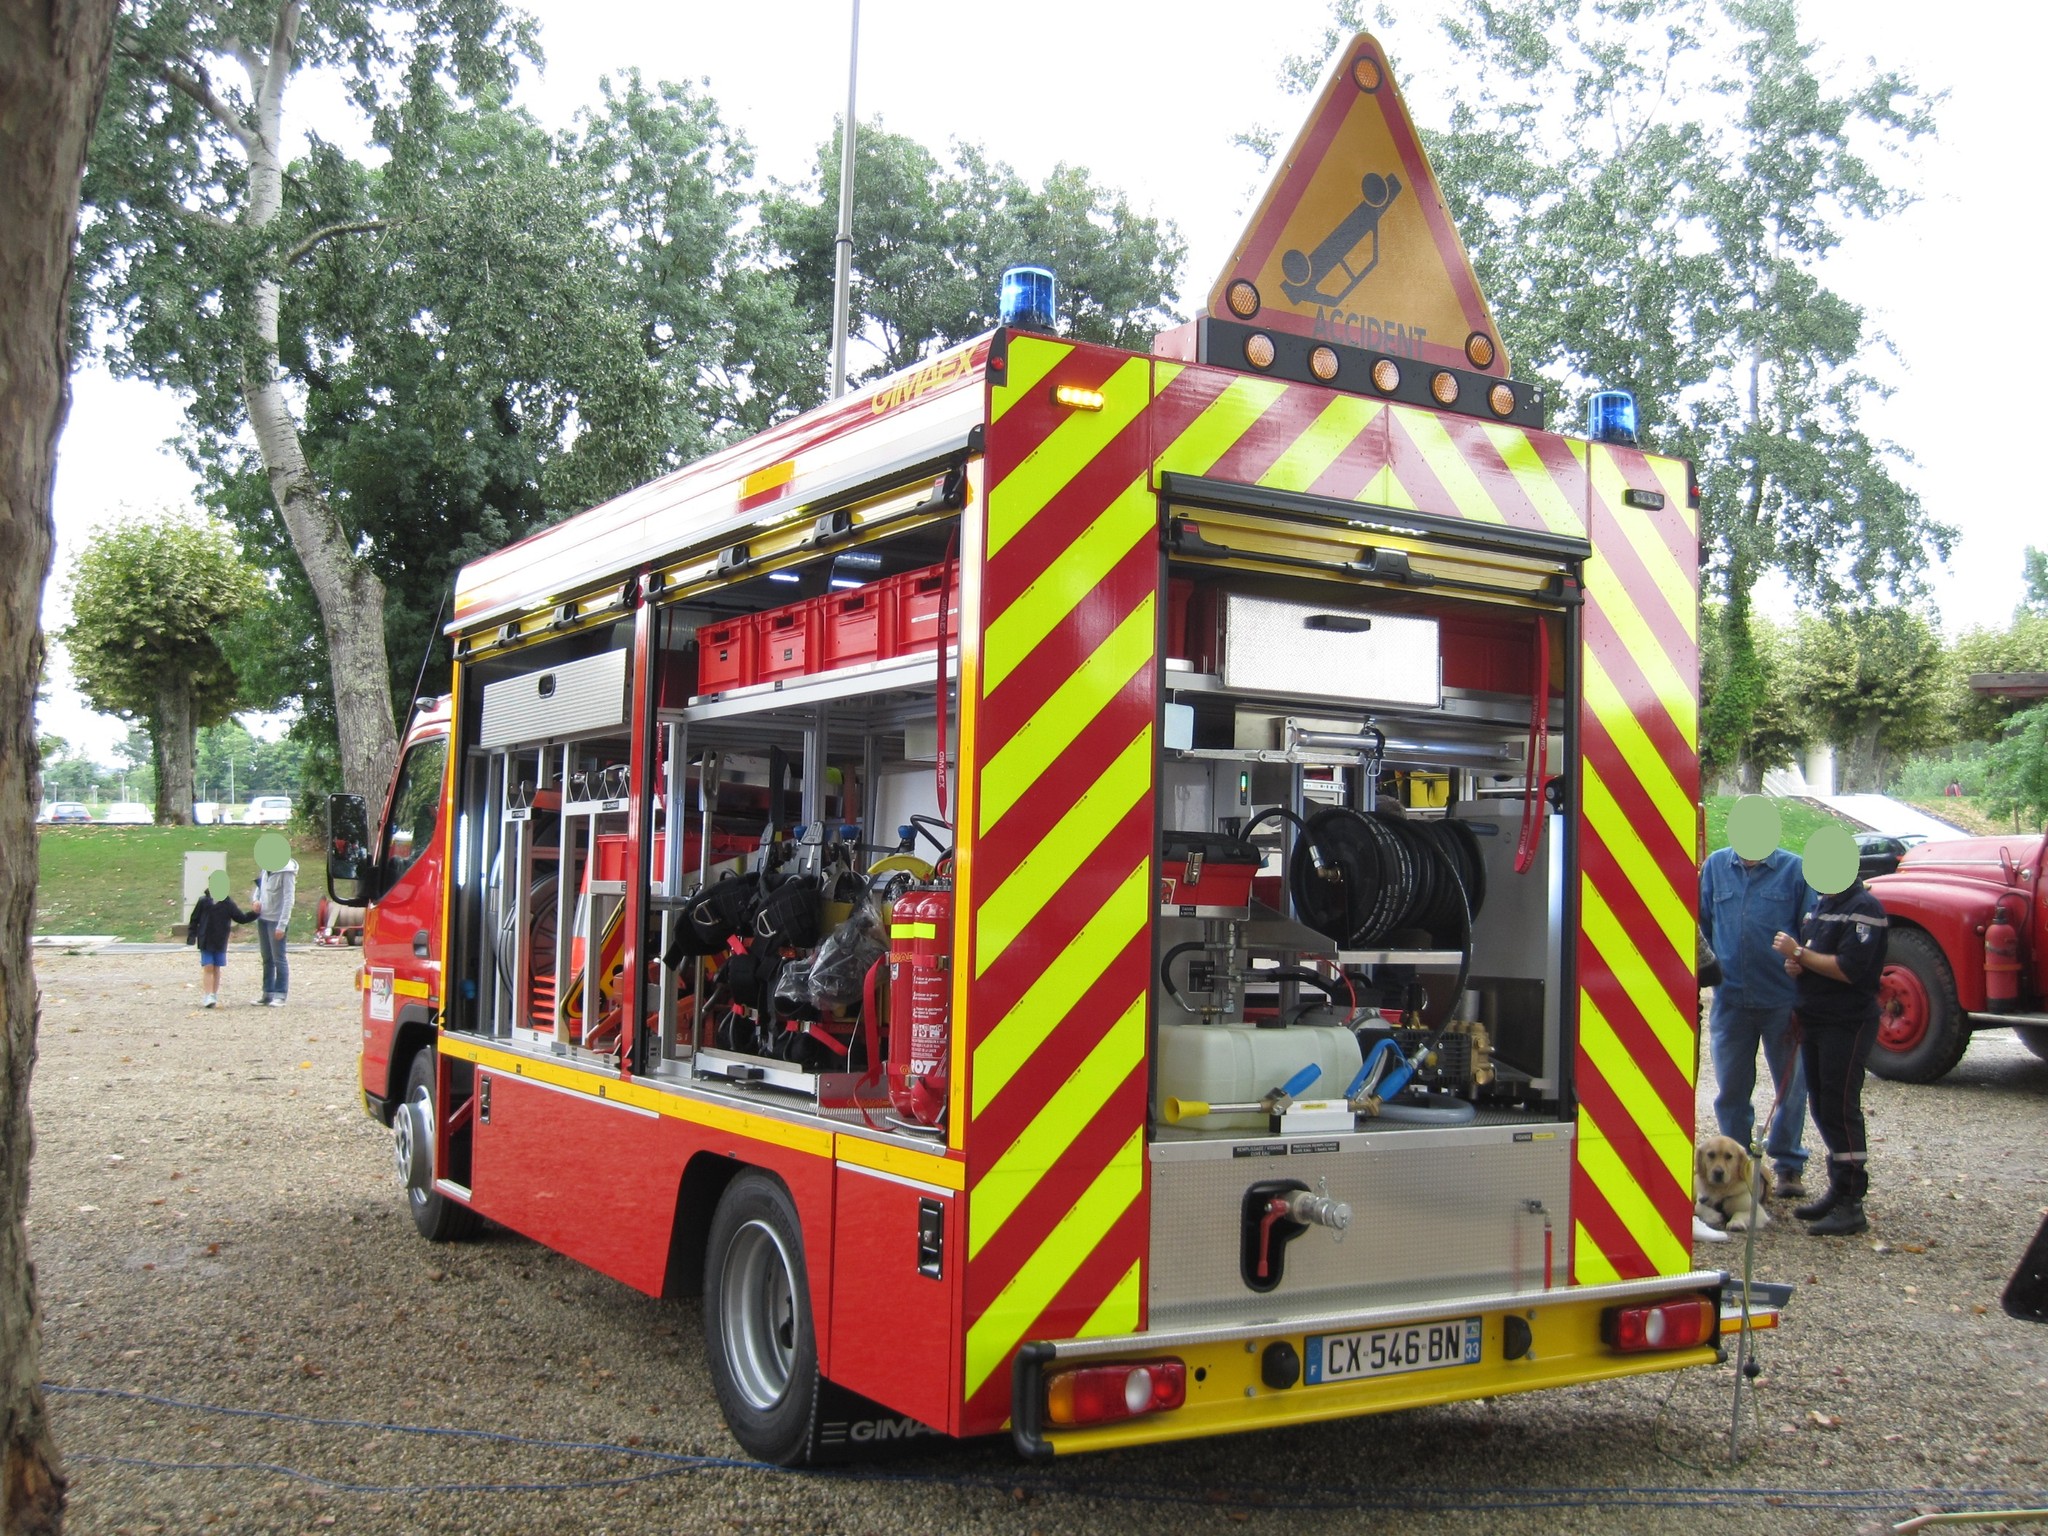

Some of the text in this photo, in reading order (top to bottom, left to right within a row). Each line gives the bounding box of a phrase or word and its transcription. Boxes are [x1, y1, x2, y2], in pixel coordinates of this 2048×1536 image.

[1312, 305, 1427, 360] ACCIDENT
[1310, 1365, 1317, 1376] F
[1465, 1342, 1479, 1359] 33
[851, 1418, 944, 1441] GIMA
